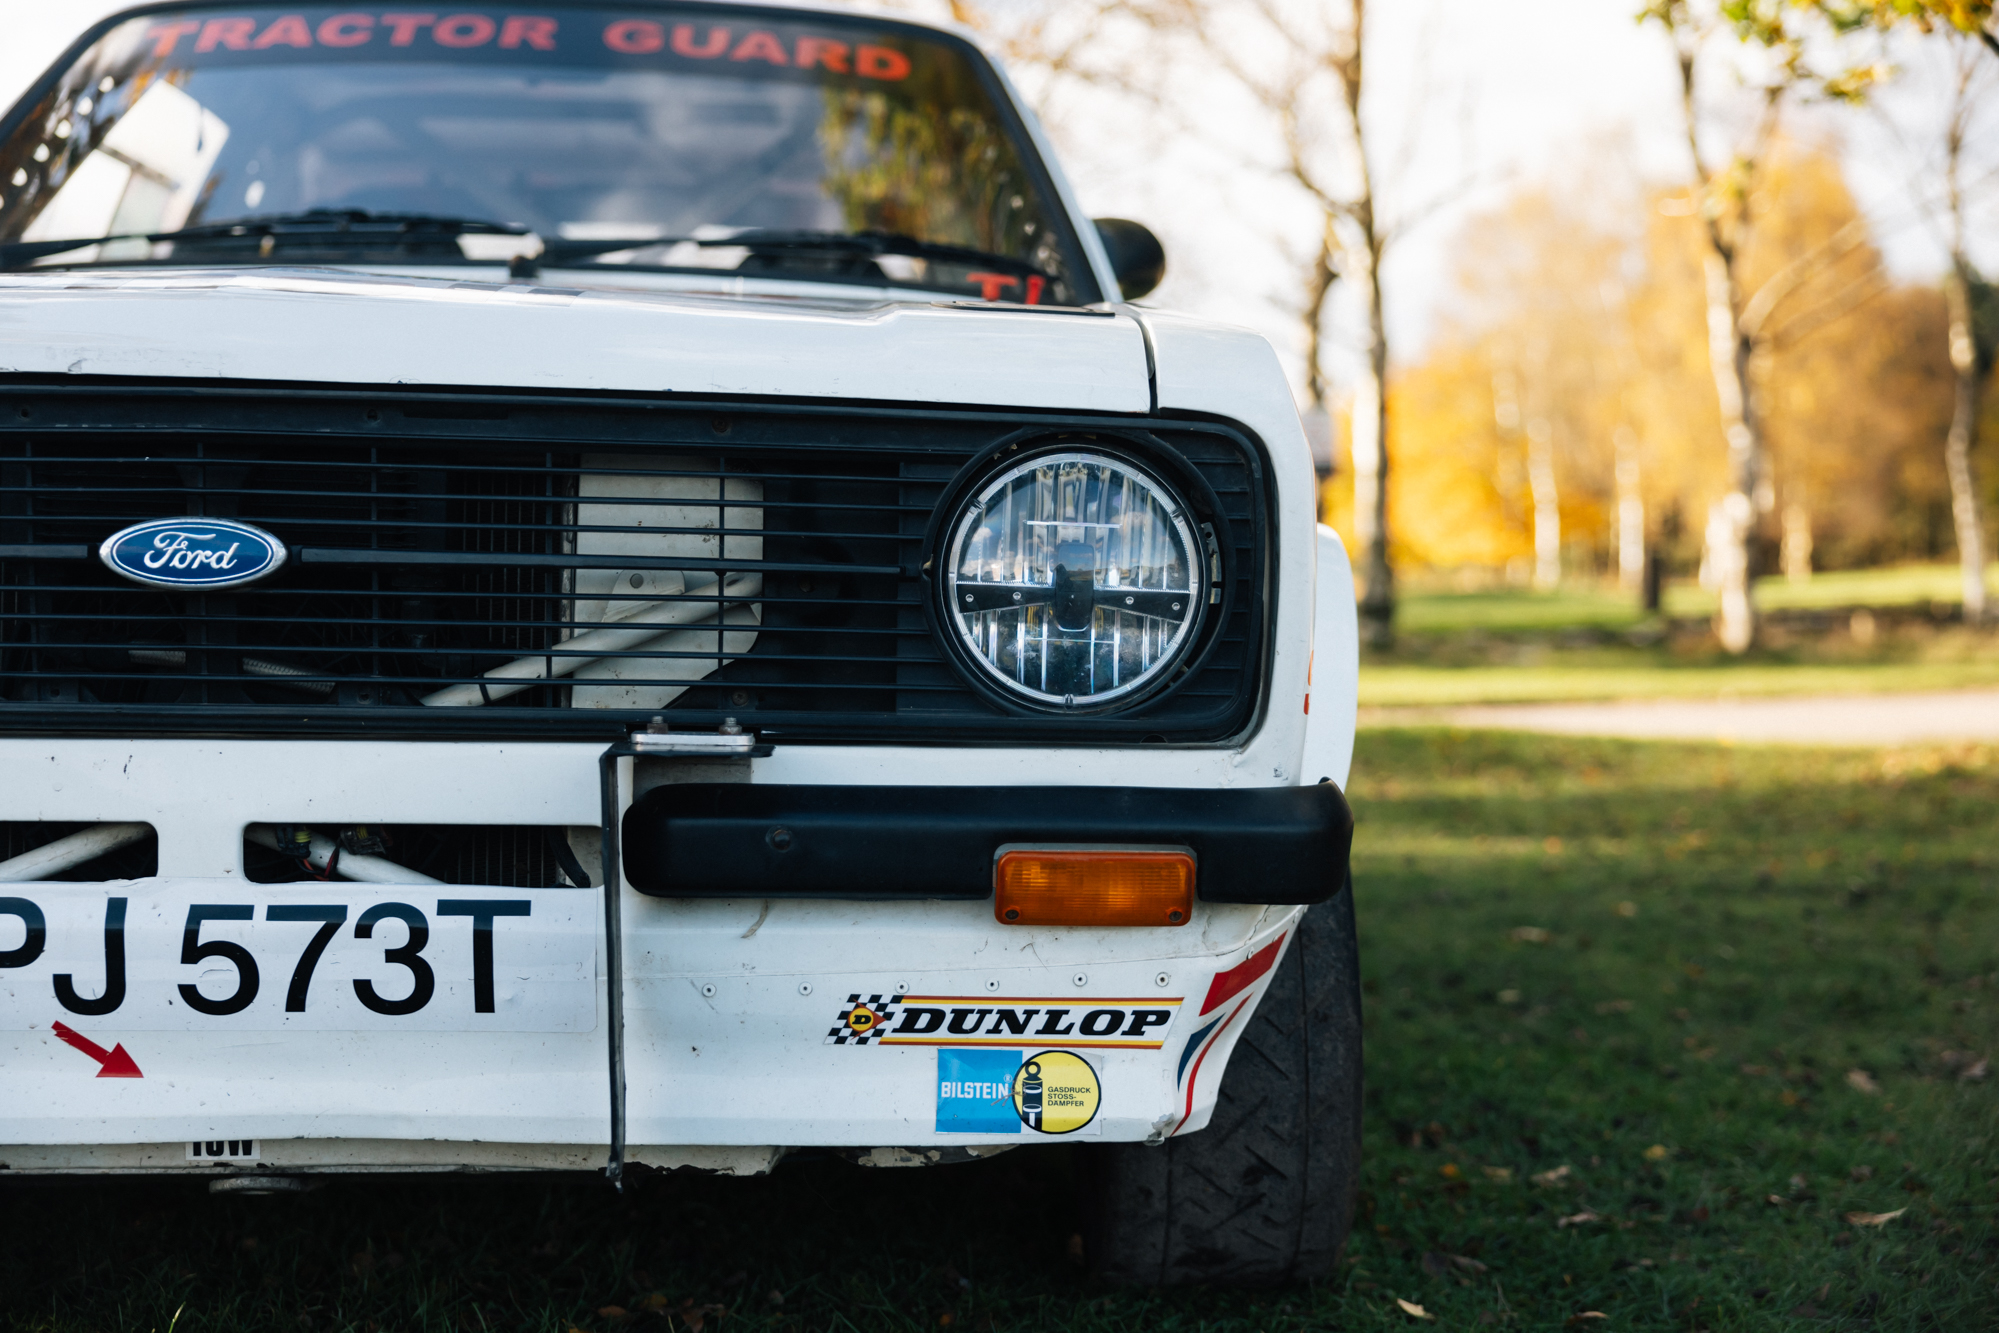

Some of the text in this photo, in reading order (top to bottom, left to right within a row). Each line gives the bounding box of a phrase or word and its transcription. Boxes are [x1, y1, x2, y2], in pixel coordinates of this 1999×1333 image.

[146, 13, 912, 82] TRACTOR GUARD
[144, 531, 240, 569] Ford
[177, 899, 532, 1016] 573T
[852, 1007, 1172, 1036] D DUNLOP
[1047, 1086, 1091, 1094] GASDRUCK
